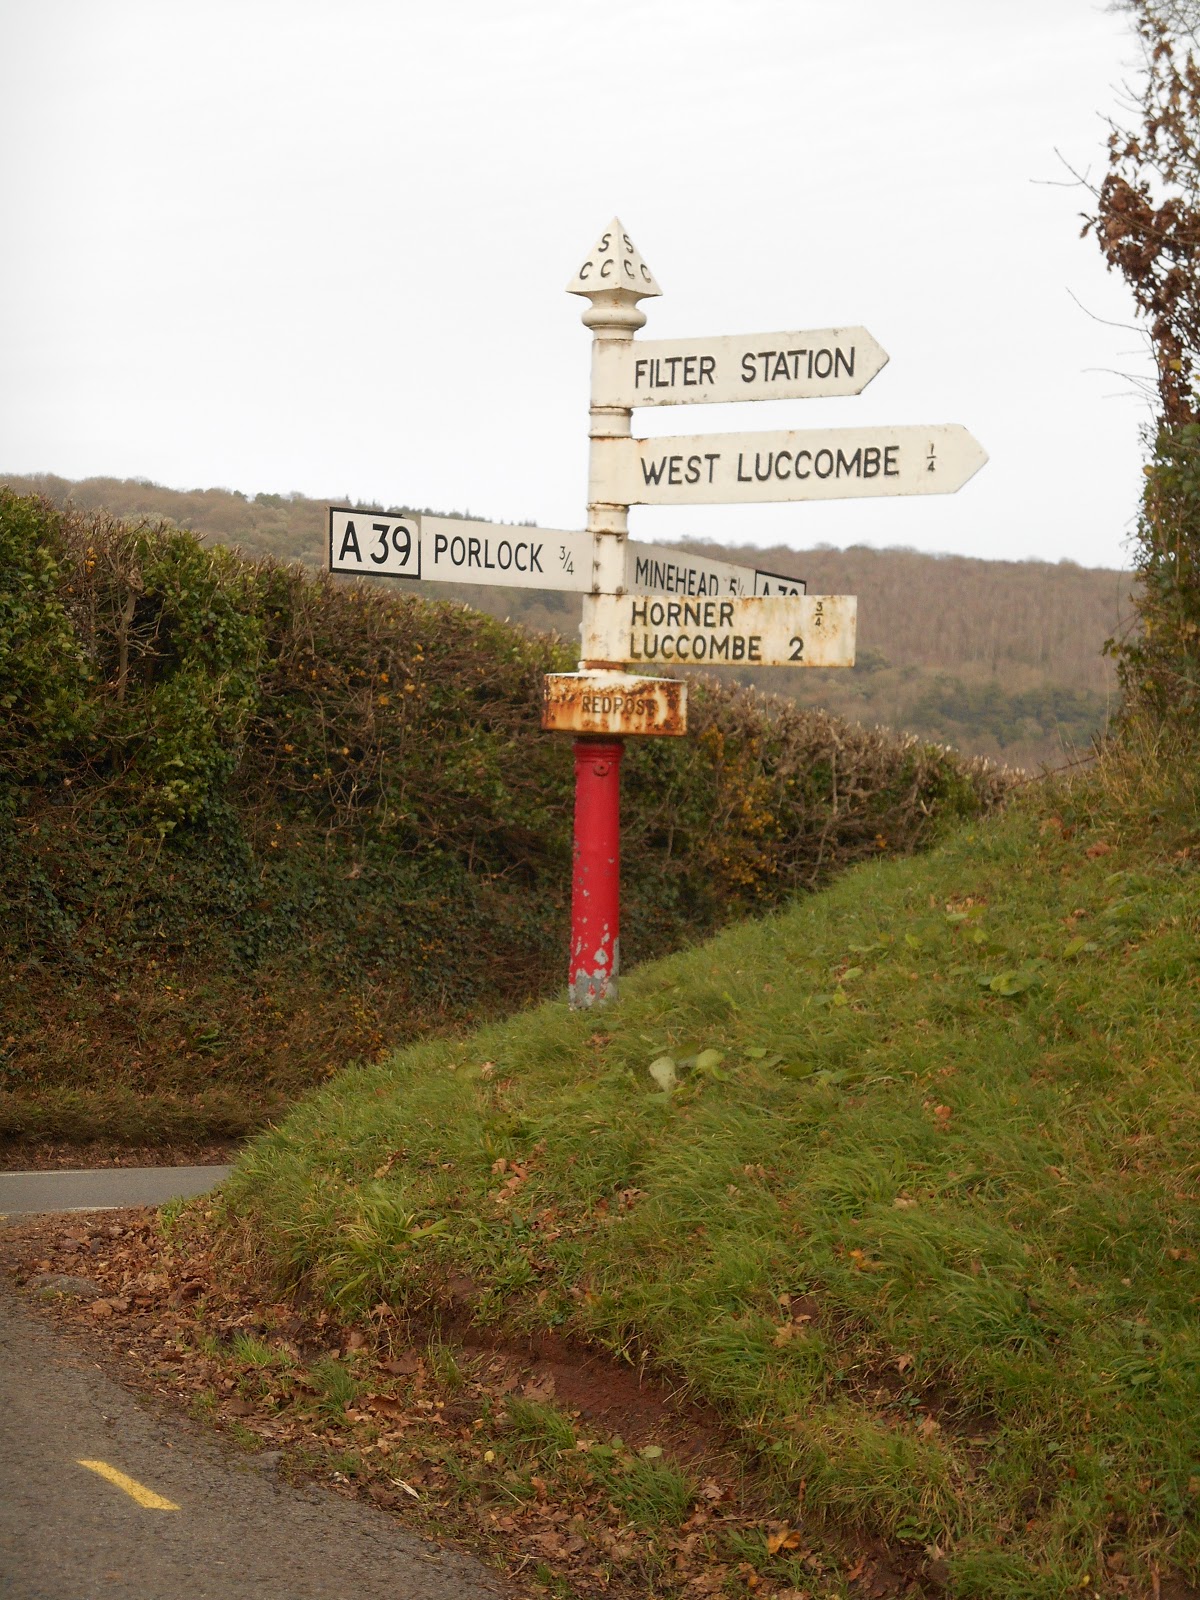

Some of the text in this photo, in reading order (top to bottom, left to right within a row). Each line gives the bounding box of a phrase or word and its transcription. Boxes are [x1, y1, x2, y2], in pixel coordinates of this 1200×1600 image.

[634, 345, 856, 389] FILTER STATION
[640, 453, 721, 486] WEST
[736, 445, 901, 483] LUCCOMBE
[434, 533, 545, 574] PORLOCK
[635, 556, 719, 597] MINEHEAD
[631, 601, 735, 628] HORNER
[629, 633, 805, 662] LUCCOMBE 2
